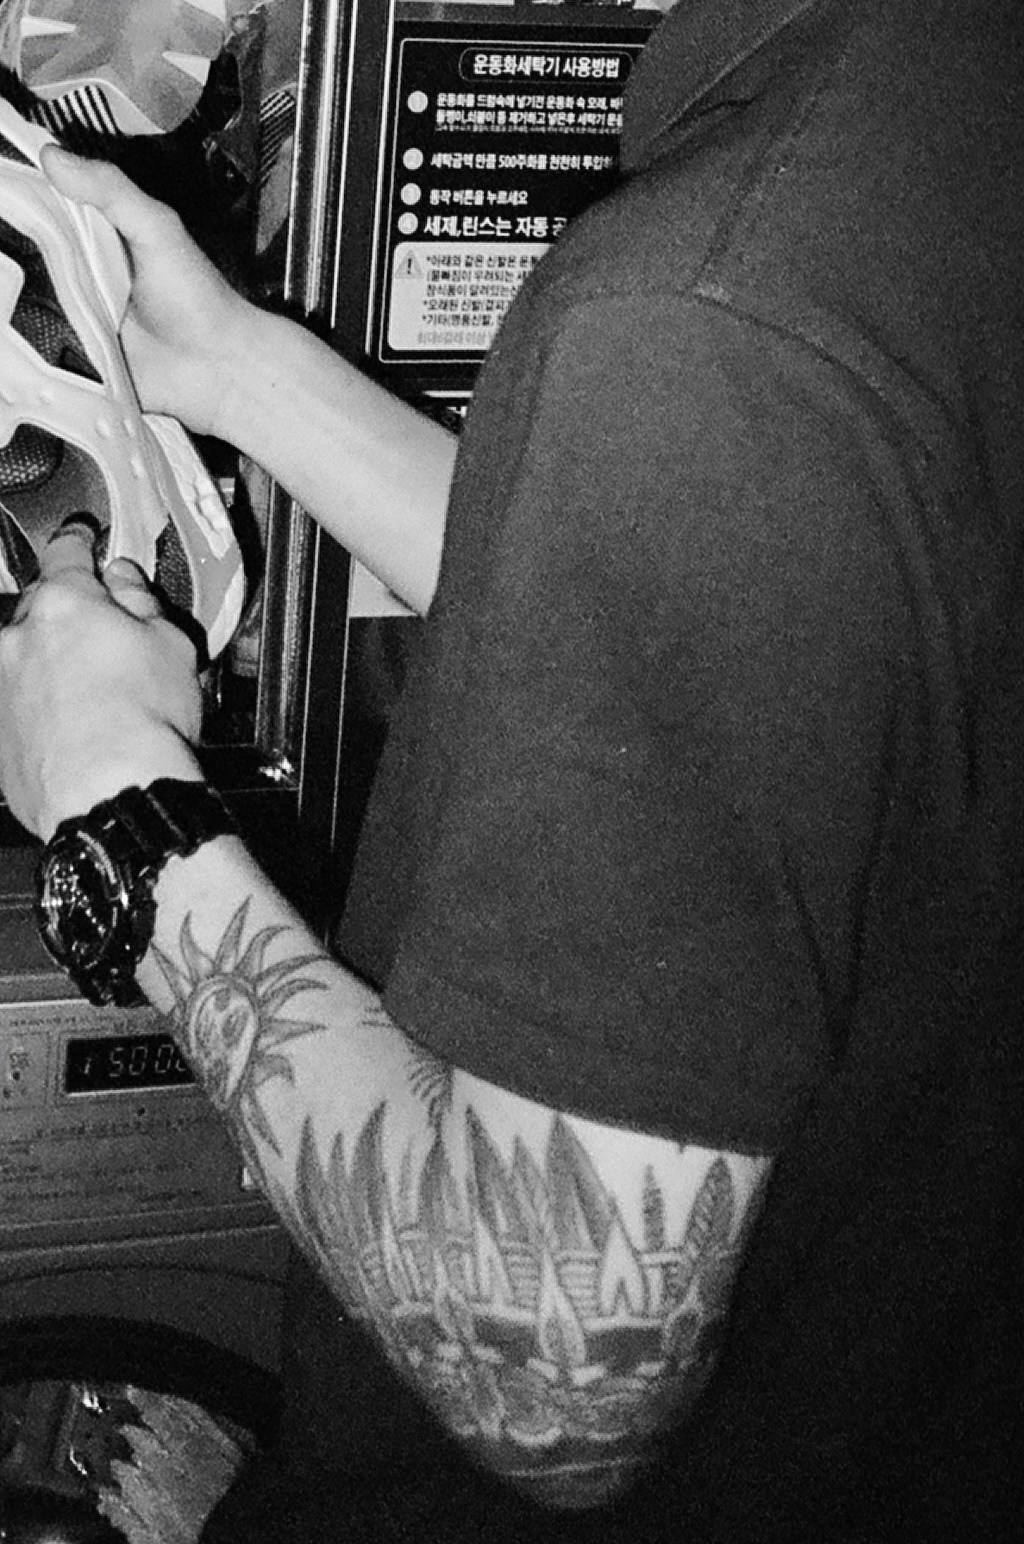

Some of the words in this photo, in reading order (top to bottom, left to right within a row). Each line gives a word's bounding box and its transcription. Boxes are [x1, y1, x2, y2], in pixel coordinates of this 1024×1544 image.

[473, 54, 560, 77] 운동화세탁기
[563, 56, 621, 79] 사용방법
[486, 190, 528, 205] 누르세요
[515, 216, 548, 237] 자동
